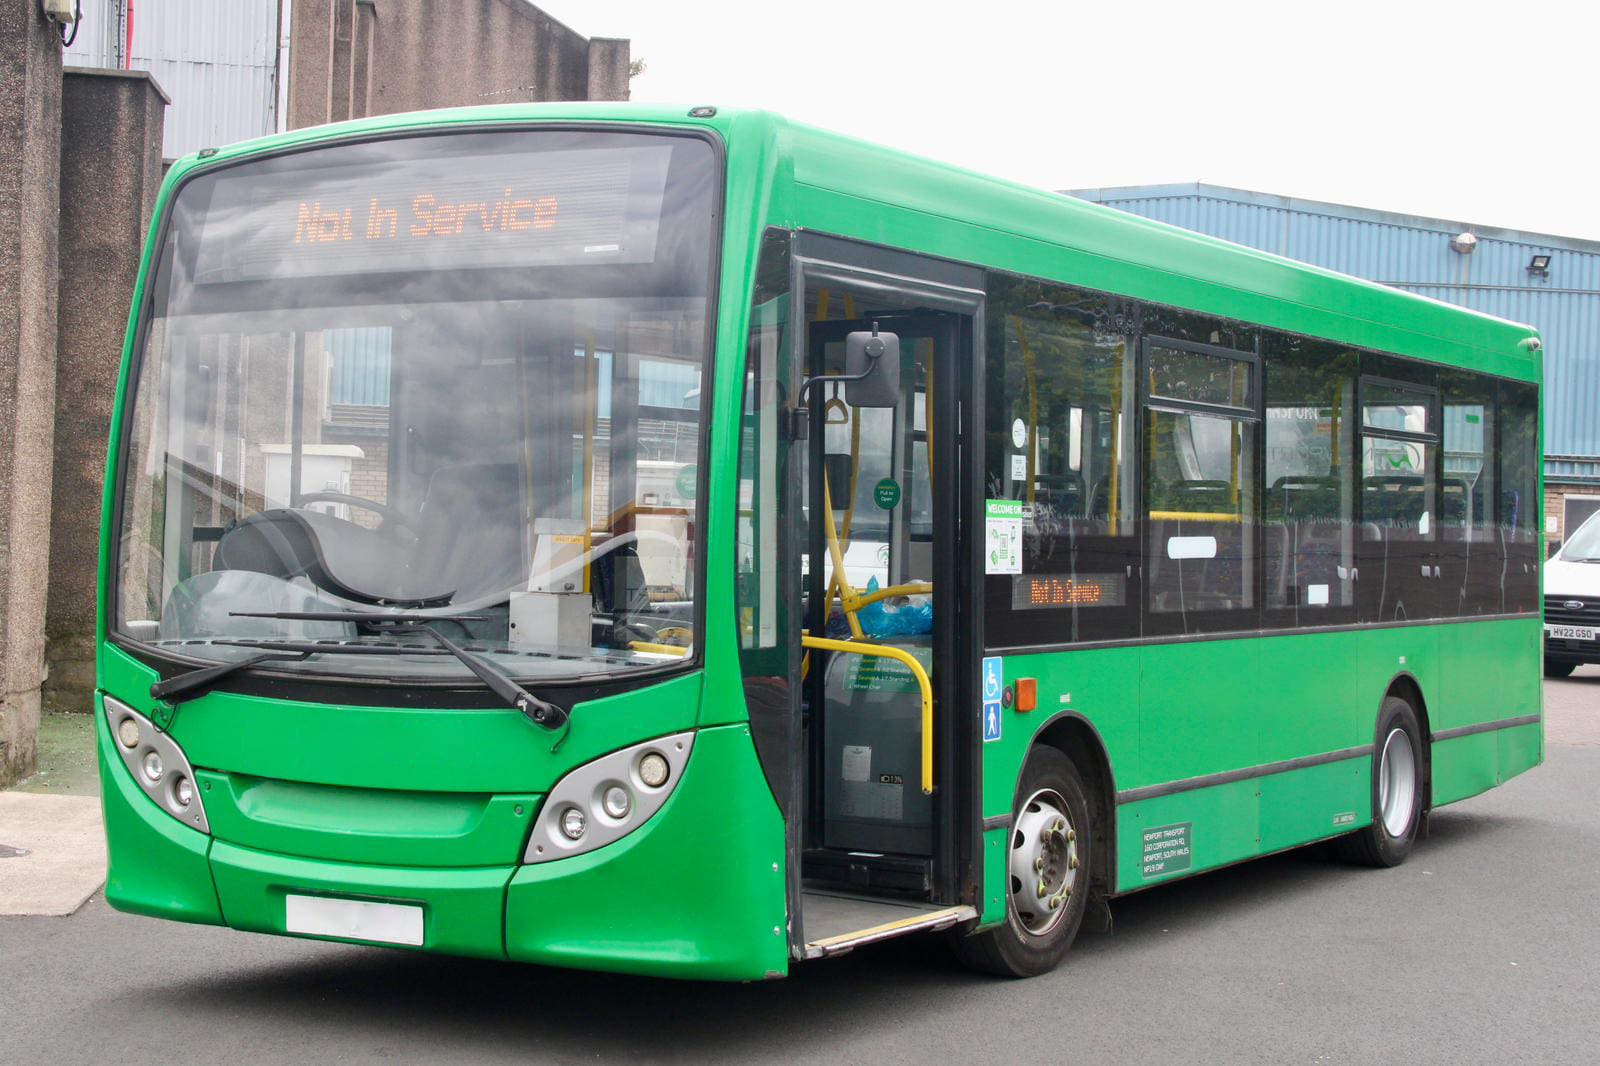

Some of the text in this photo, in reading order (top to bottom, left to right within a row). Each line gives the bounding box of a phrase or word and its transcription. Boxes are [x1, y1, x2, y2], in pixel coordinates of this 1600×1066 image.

[294, 187, 558, 243] Not In Service
[988, 504, 1014, 514] WELCOME
[1031, 578, 1100, 603] Not In Service
[1553, 628, 1574, 638] HV22
[1144, 828, 1184, 841] NEWPORT TRANSPORT
[1163, 850, 1176, 858] SOUTH
